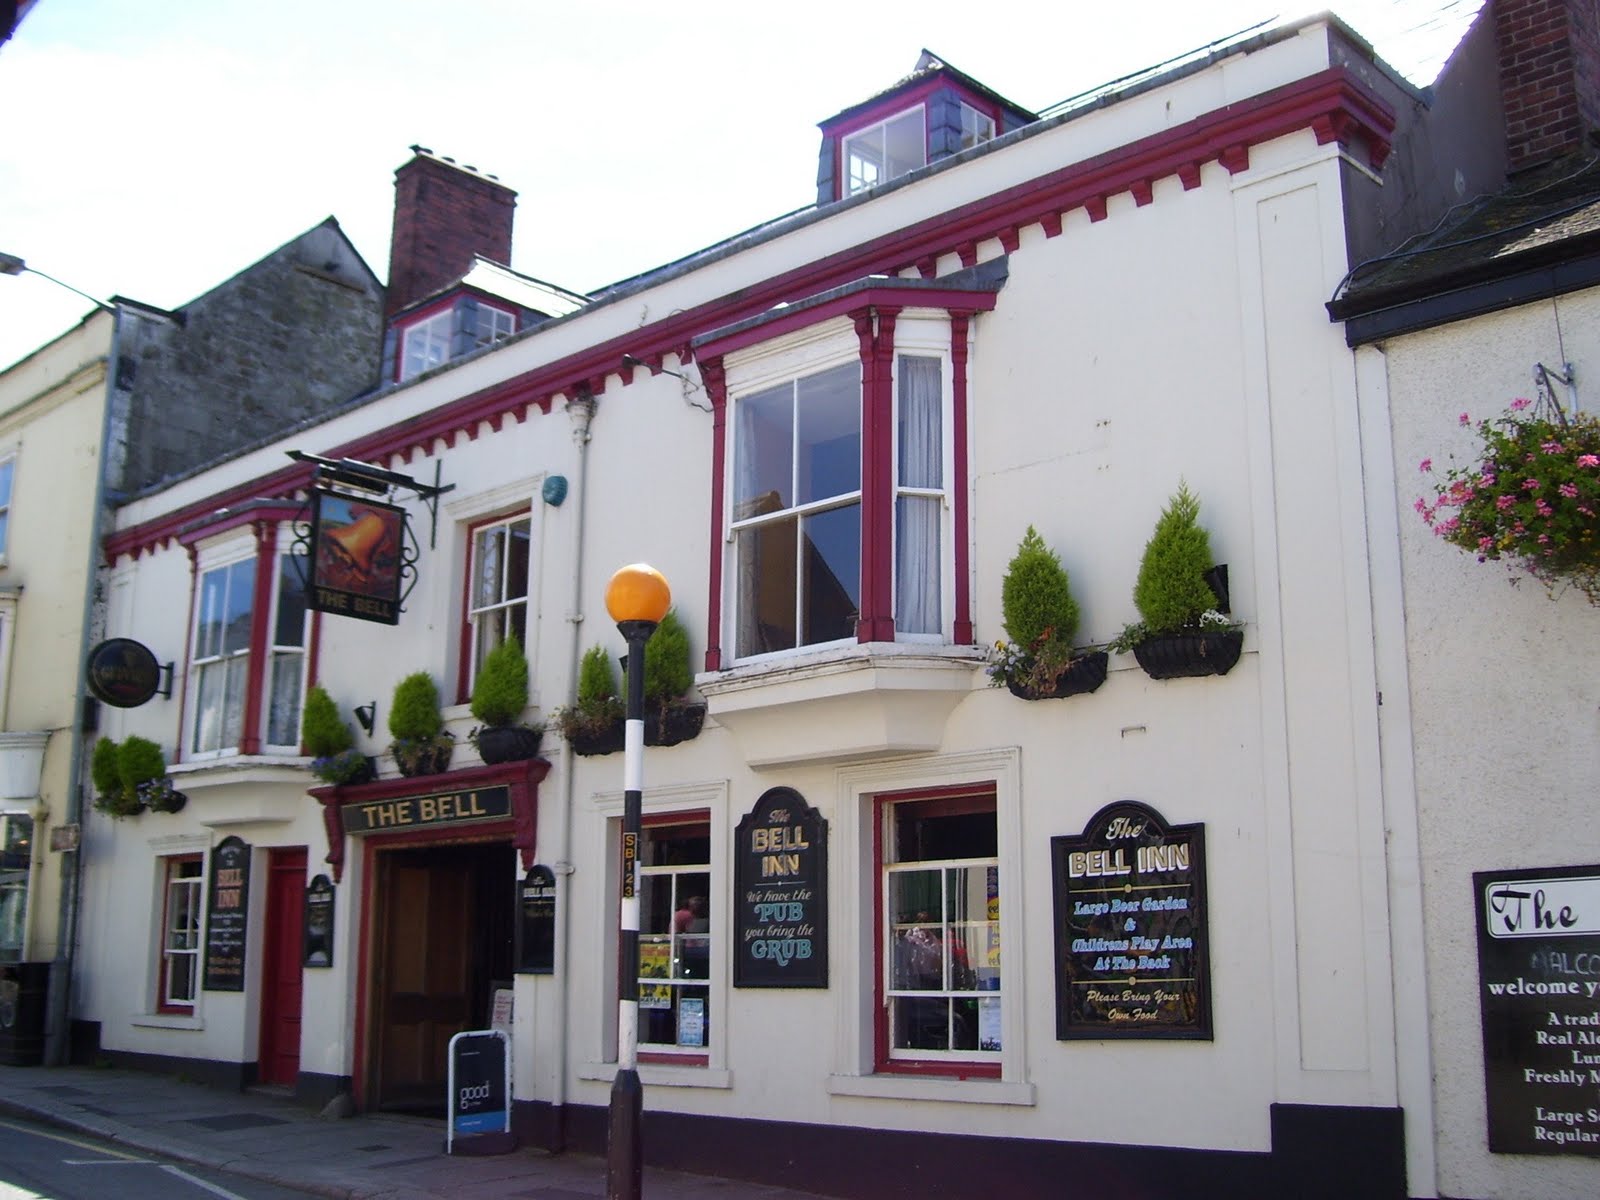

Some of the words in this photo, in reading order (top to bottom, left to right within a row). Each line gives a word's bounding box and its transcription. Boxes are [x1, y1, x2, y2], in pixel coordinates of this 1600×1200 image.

[362, 801, 413, 828] THE
[419, 793, 486, 822] BELL
[768, 809, 791, 823] The
[1105, 817, 1145, 840] The
[752, 826, 809, 852] BELL
[762, 854, 800, 877] INN
[1068, 848, 1131, 878] BELL
[1137, 843, 1190, 874] INN
[746, 890, 762, 902] We
[763, 890, 790, 902] have
[792, 889, 812, 900] the
[754, 902, 803, 922] PUB
[1074, 902, 1109, 915] Large
[1110, 899, 1140, 913] Beer
[1141, 896, 1188, 912] Garden
[1491, 884, 1578, 932] The
[744, 927, 765, 941] you
[767, 925, 796, 939] bring
[797, 923, 814, 936] the
[1124, 917, 1137, 931] &
[751, 939, 812, 966] GRUB
[1071, 937, 1129, 952] Childrens
[1130, 936, 1160, 951] Play
[1161, 935, 1193, 949] Area
[1093, 957, 1111, 971] At
[1112, 955, 1137, 970] The
[1137, 955, 1171, 969] Back
[1087, 990, 1119, 1002] Please
[1122, 990, 1151, 1004] Bring
[1154, 989, 1180, 1004] Your
[1488, 977, 1580, 995] welcome
[1584, 981, 1600, 998] y
[1108, 1008, 1129, 1020] Own
[1132, 1008, 1158, 1021] Food
[1548, 1012, 1561, 1025] A
[1536, 1031, 1573, 1045] Real
[1524, 1069, 1586, 1086] Freshly
[460, 1080, 490, 1109] good
[1536, 1106, 1584, 1125] Large
[1534, 1126, 1600, 1144] Regular
